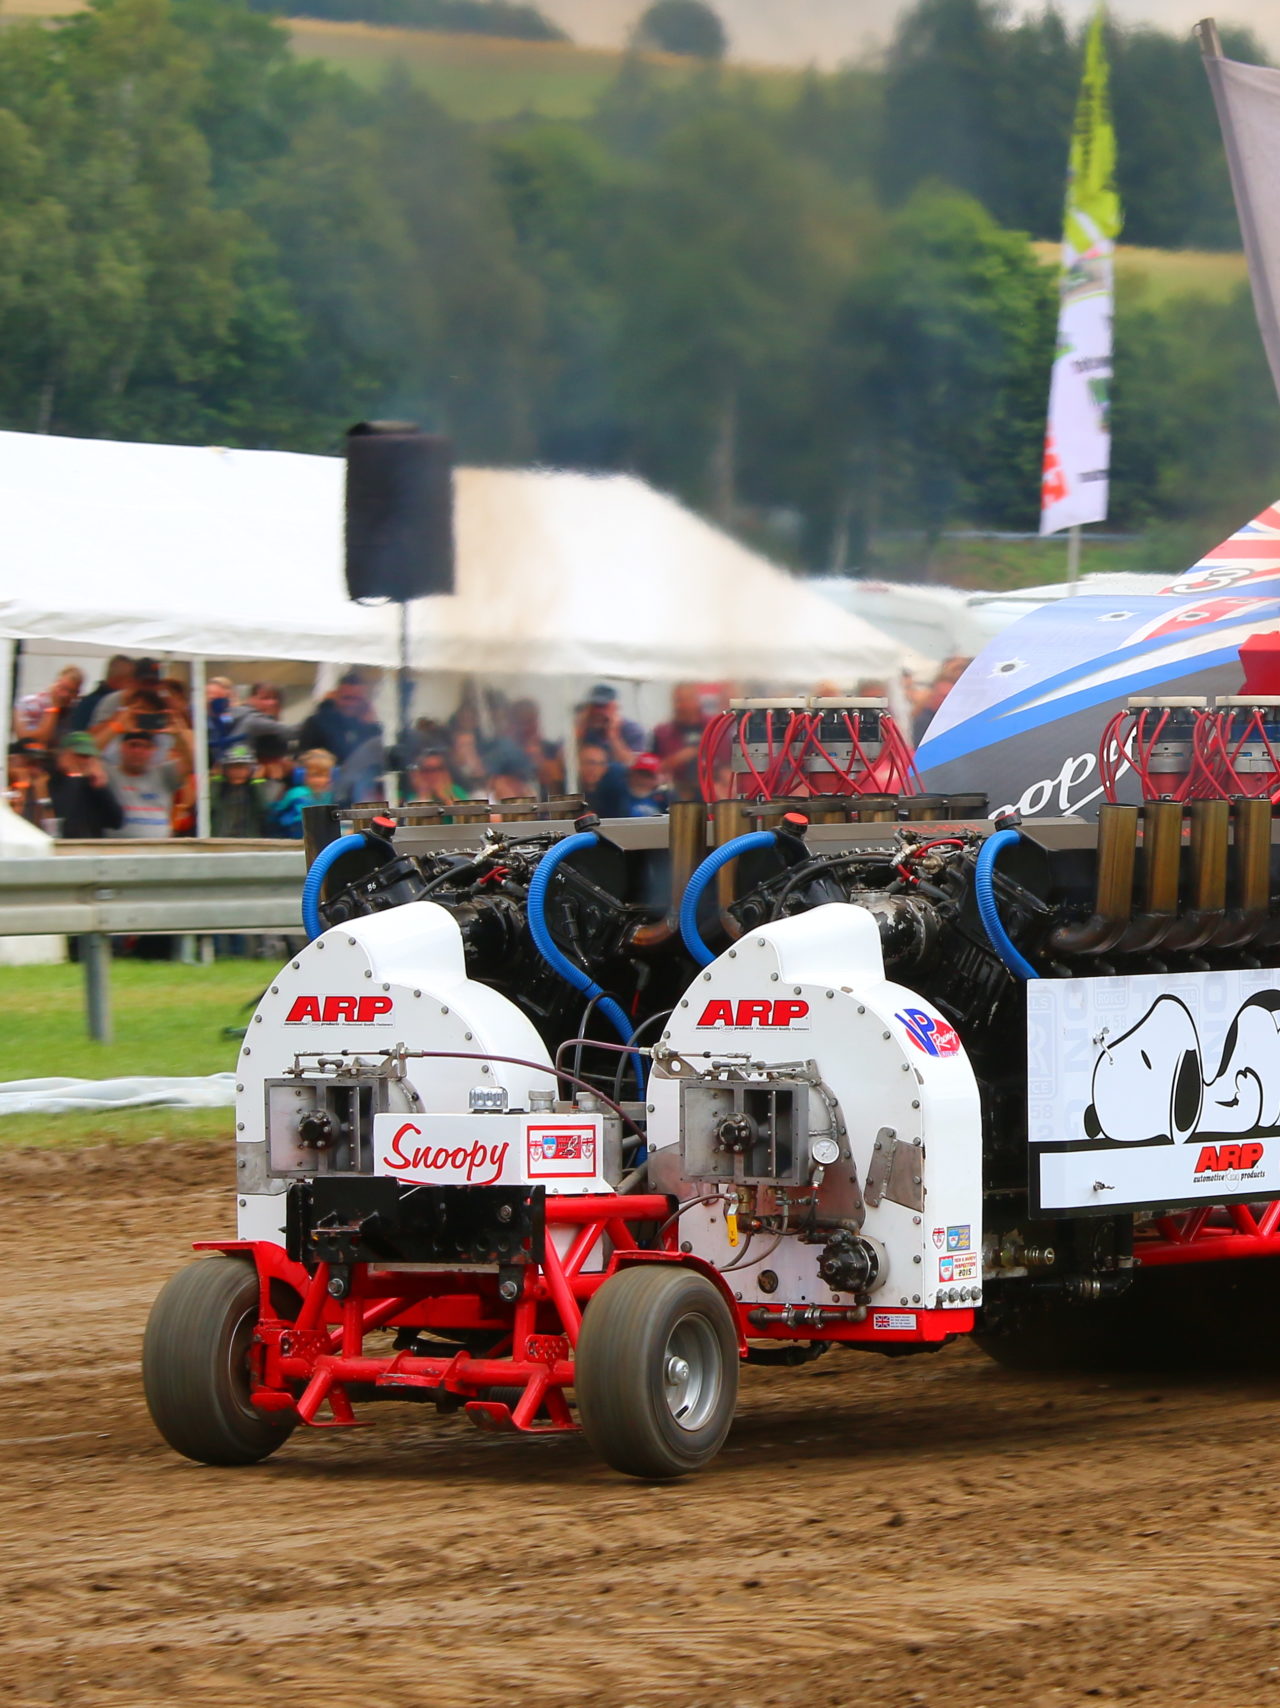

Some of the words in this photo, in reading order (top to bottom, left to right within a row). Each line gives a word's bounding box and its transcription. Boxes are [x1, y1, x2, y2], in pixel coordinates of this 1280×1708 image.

[285, 996, 393, 1022] ARP
[697, 999, 809, 1026] ARP
[894, 1008, 940, 1057] VP
[383, 1123, 510, 1185] Snoopy
[1194, 1142, 1264, 1173] ARP
[1193, 1173, 1225, 1183] automotive
[1240, 1170, 1265, 1181] products
